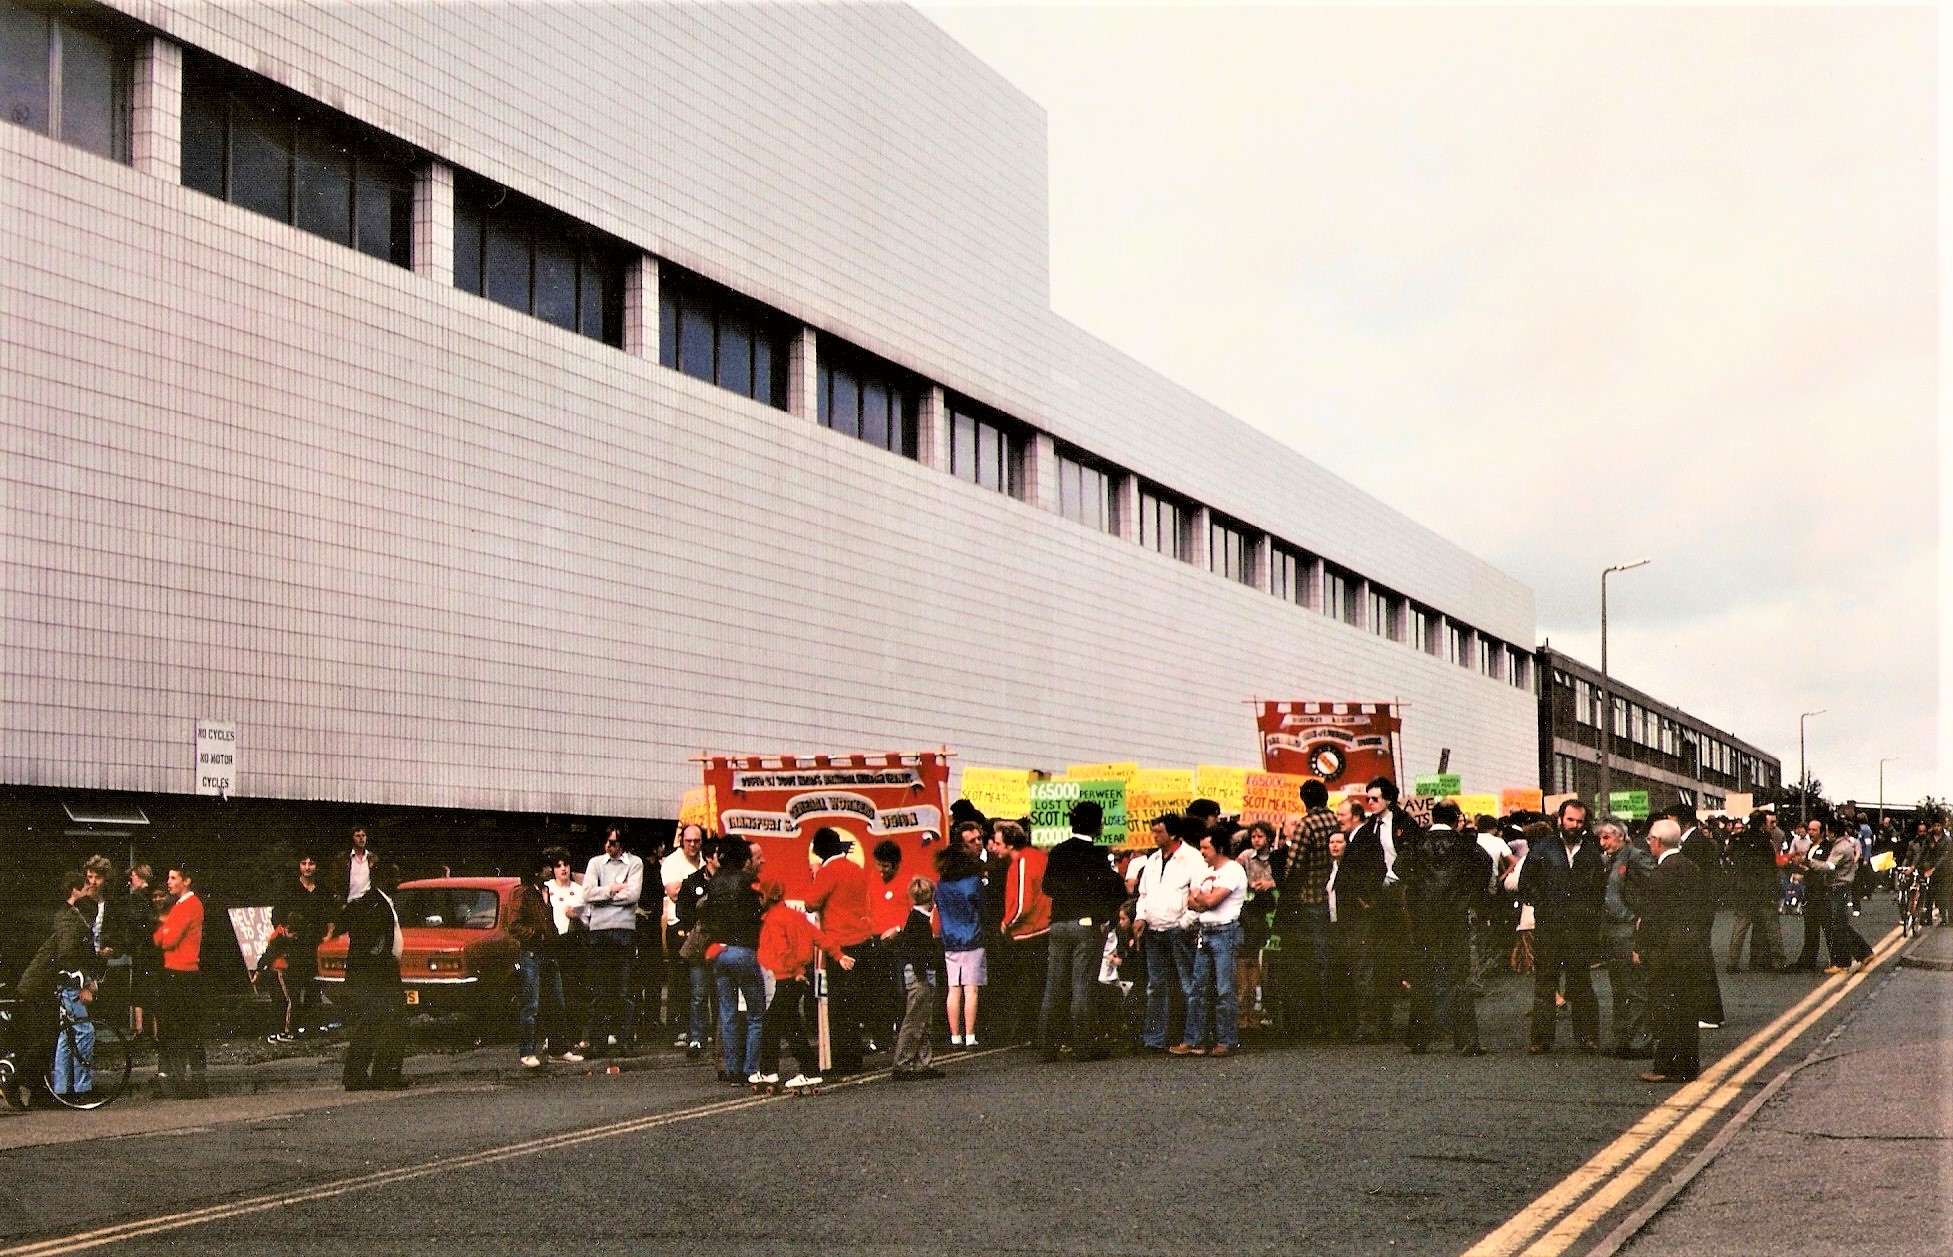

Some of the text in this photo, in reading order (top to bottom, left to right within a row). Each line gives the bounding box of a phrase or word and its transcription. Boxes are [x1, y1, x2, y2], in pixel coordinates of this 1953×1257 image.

[198, 728, 235, 741] NO CYCLES
[200, 753, 233, 765] NO MOTOR
[202, 776, 229, 789] CYCLES
[1196, 786, 1216, 797] SCOT
[1034, 800, 1062, 810] LOST
[1242, 795, 1266, 809] SCOT
[1267, 798, 1298, 813] MEATS
[1403, 797, 1434, 811] AVE
[1030, 811, 1060, 826] SCOT
[229, 906, 255, 928] HELP
[240, 926, 255, 940] TO
